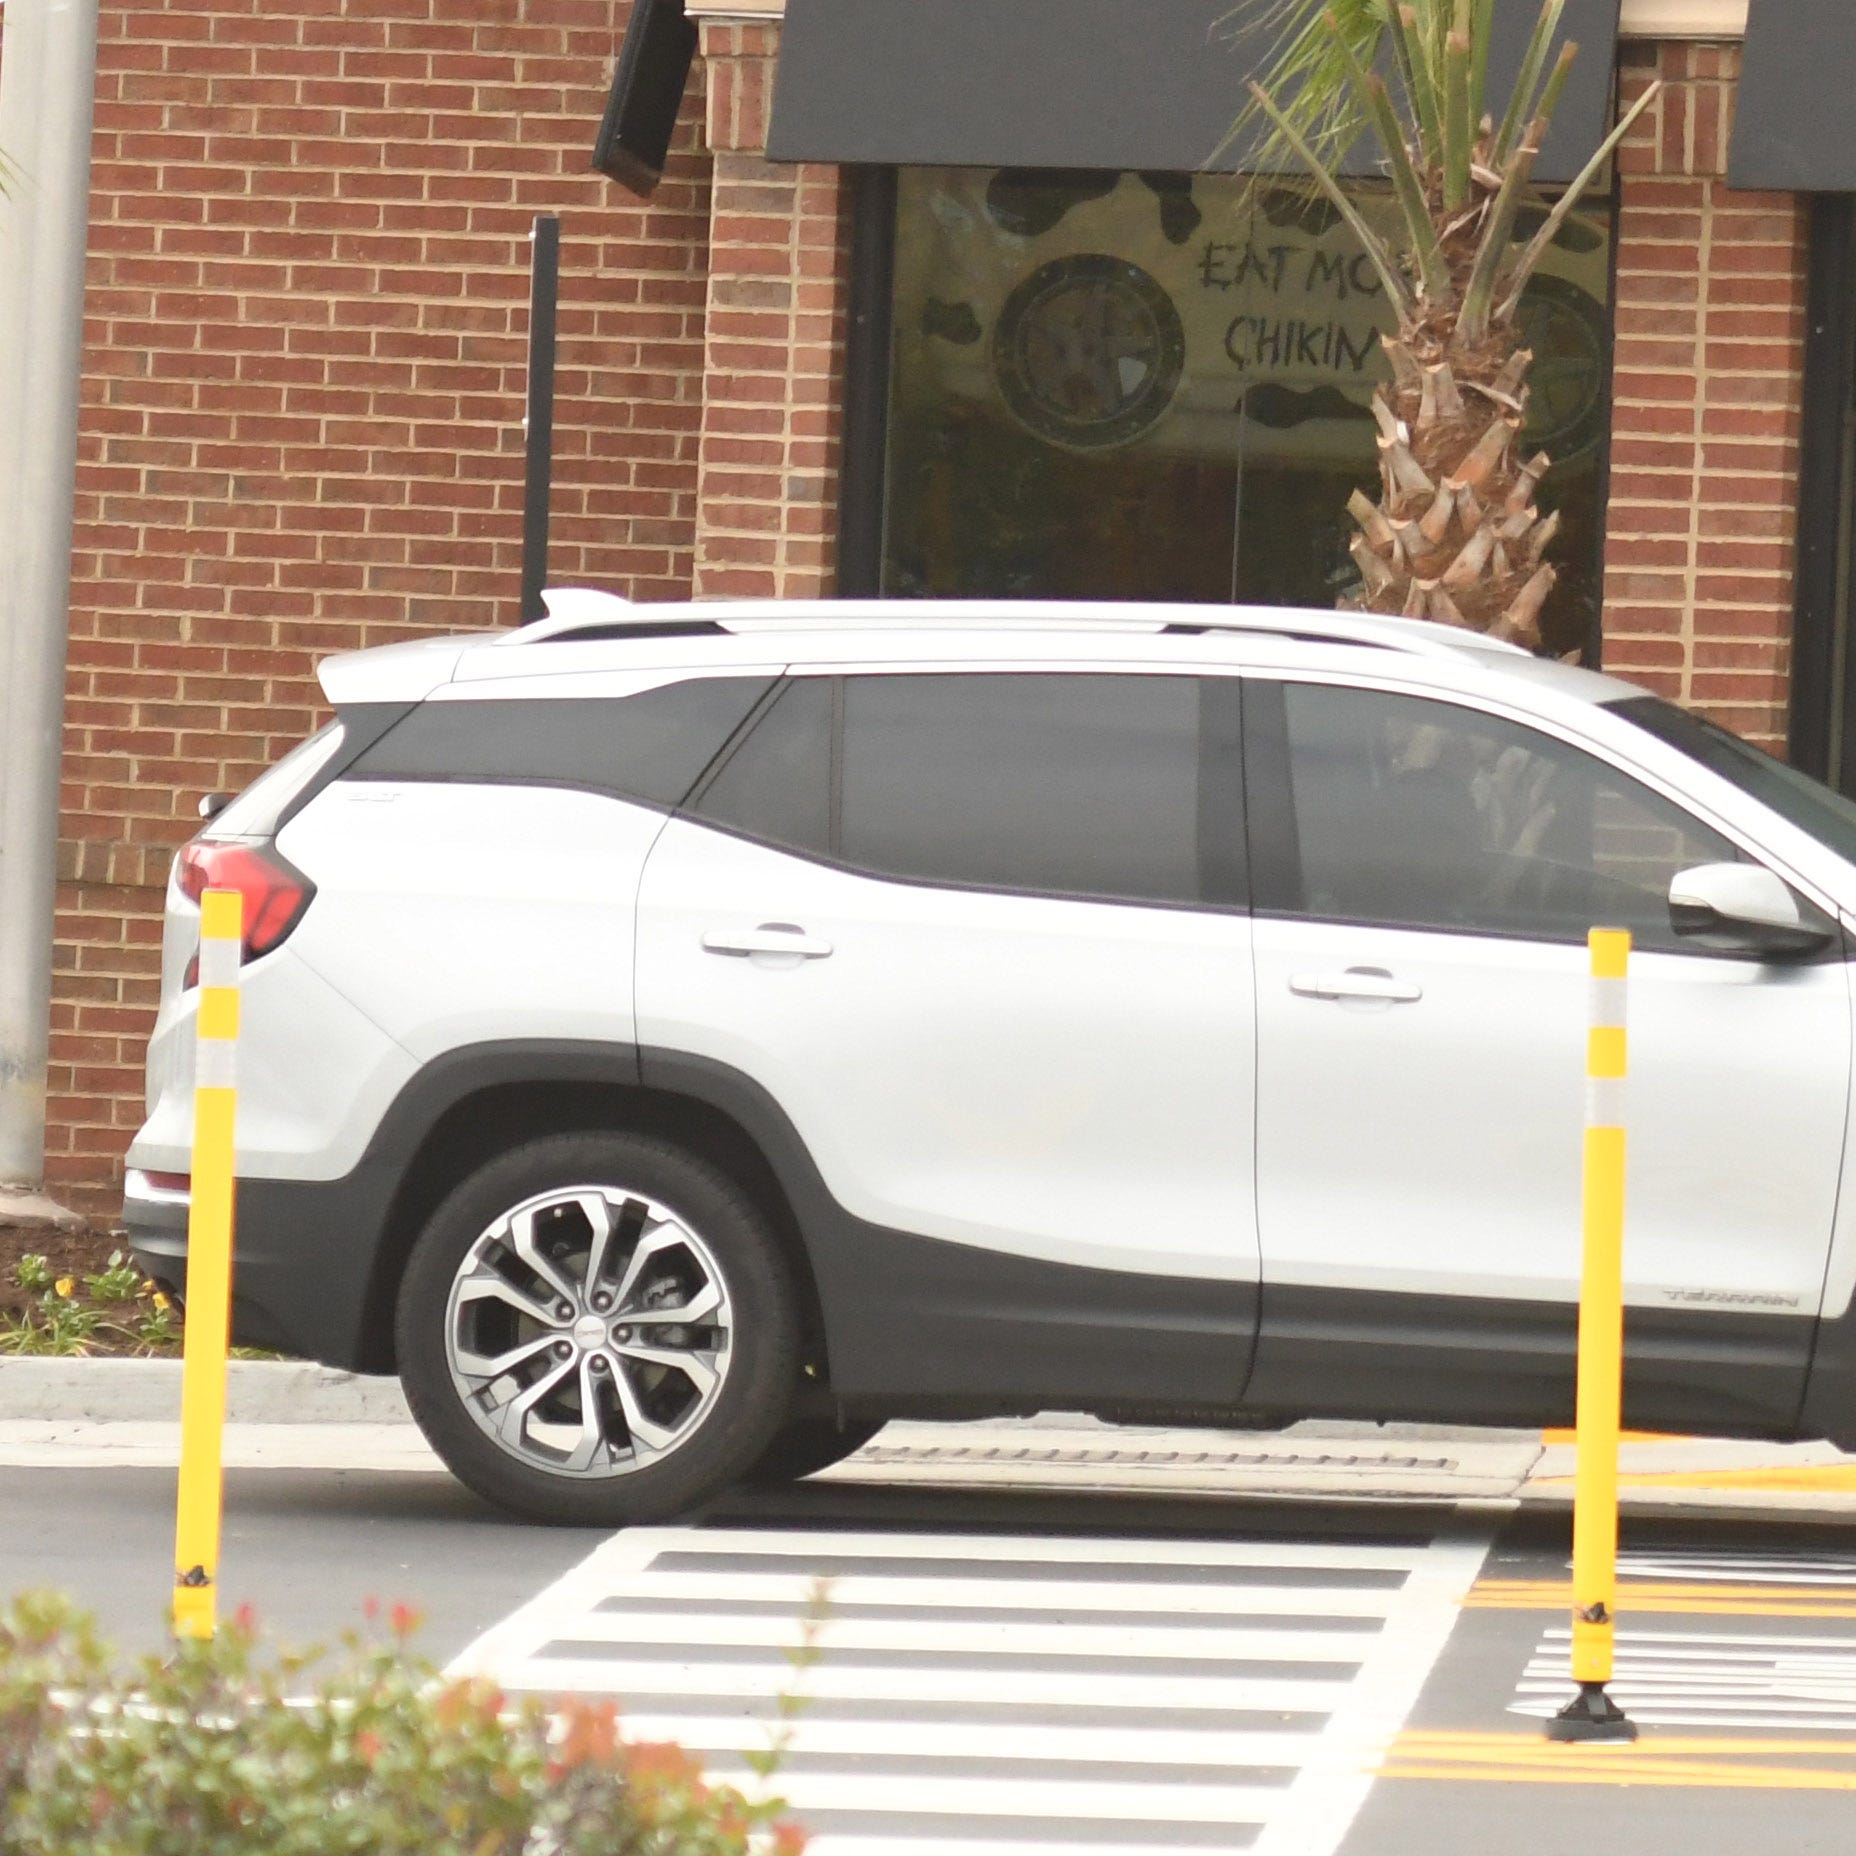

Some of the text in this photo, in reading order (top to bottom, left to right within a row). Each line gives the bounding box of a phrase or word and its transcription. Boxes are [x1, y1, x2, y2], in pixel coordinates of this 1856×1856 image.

[1197, 242, 1412, 300] EAT MO
[1225, 314, 1381, 372] CHIKIN
